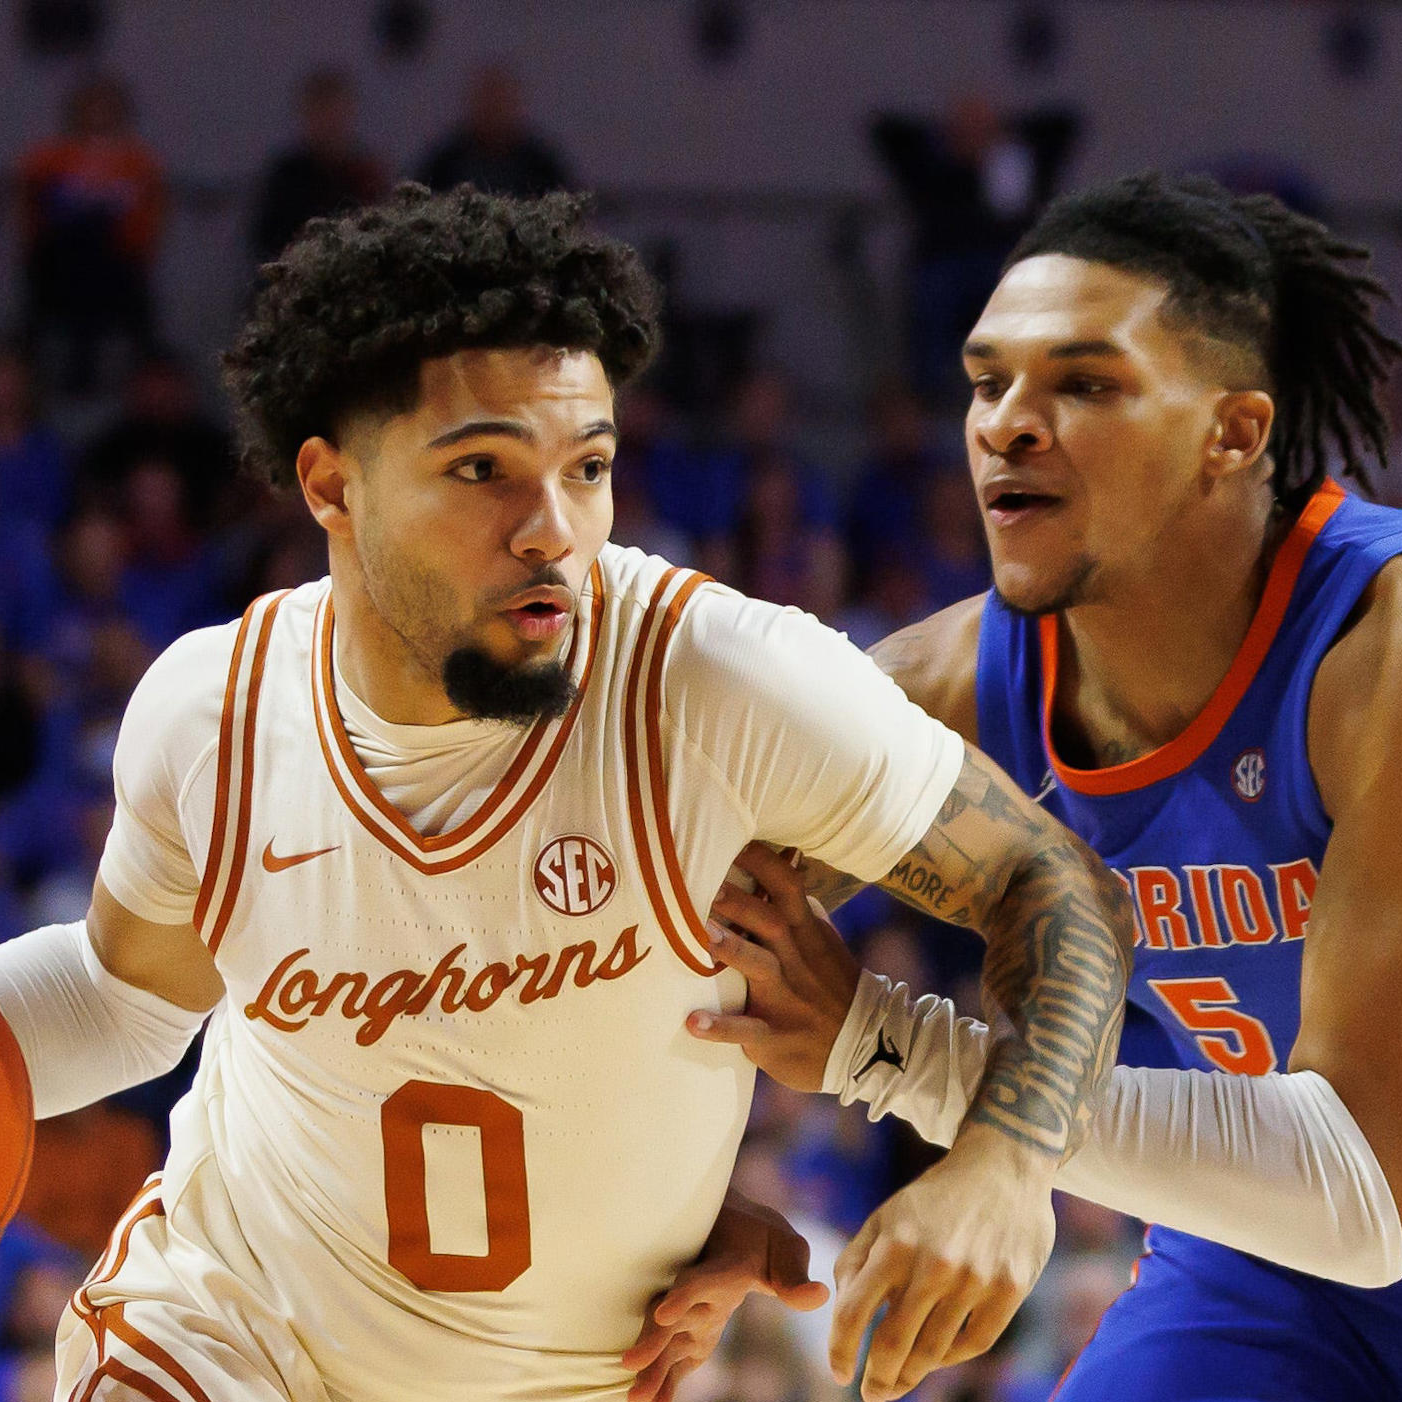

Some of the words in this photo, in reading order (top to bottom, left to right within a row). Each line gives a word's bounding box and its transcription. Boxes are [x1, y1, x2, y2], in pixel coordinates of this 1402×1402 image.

[1233, 751, 1266, 798] SEC
[538, 839, 612, 913] SEC
[1111, 857, 1320, 950] RIDA
[244, 923, 652, 1047] Longhorns
[1147, 976, 1279, 1077] 5
[380, 1079, 532, 1293] 0
